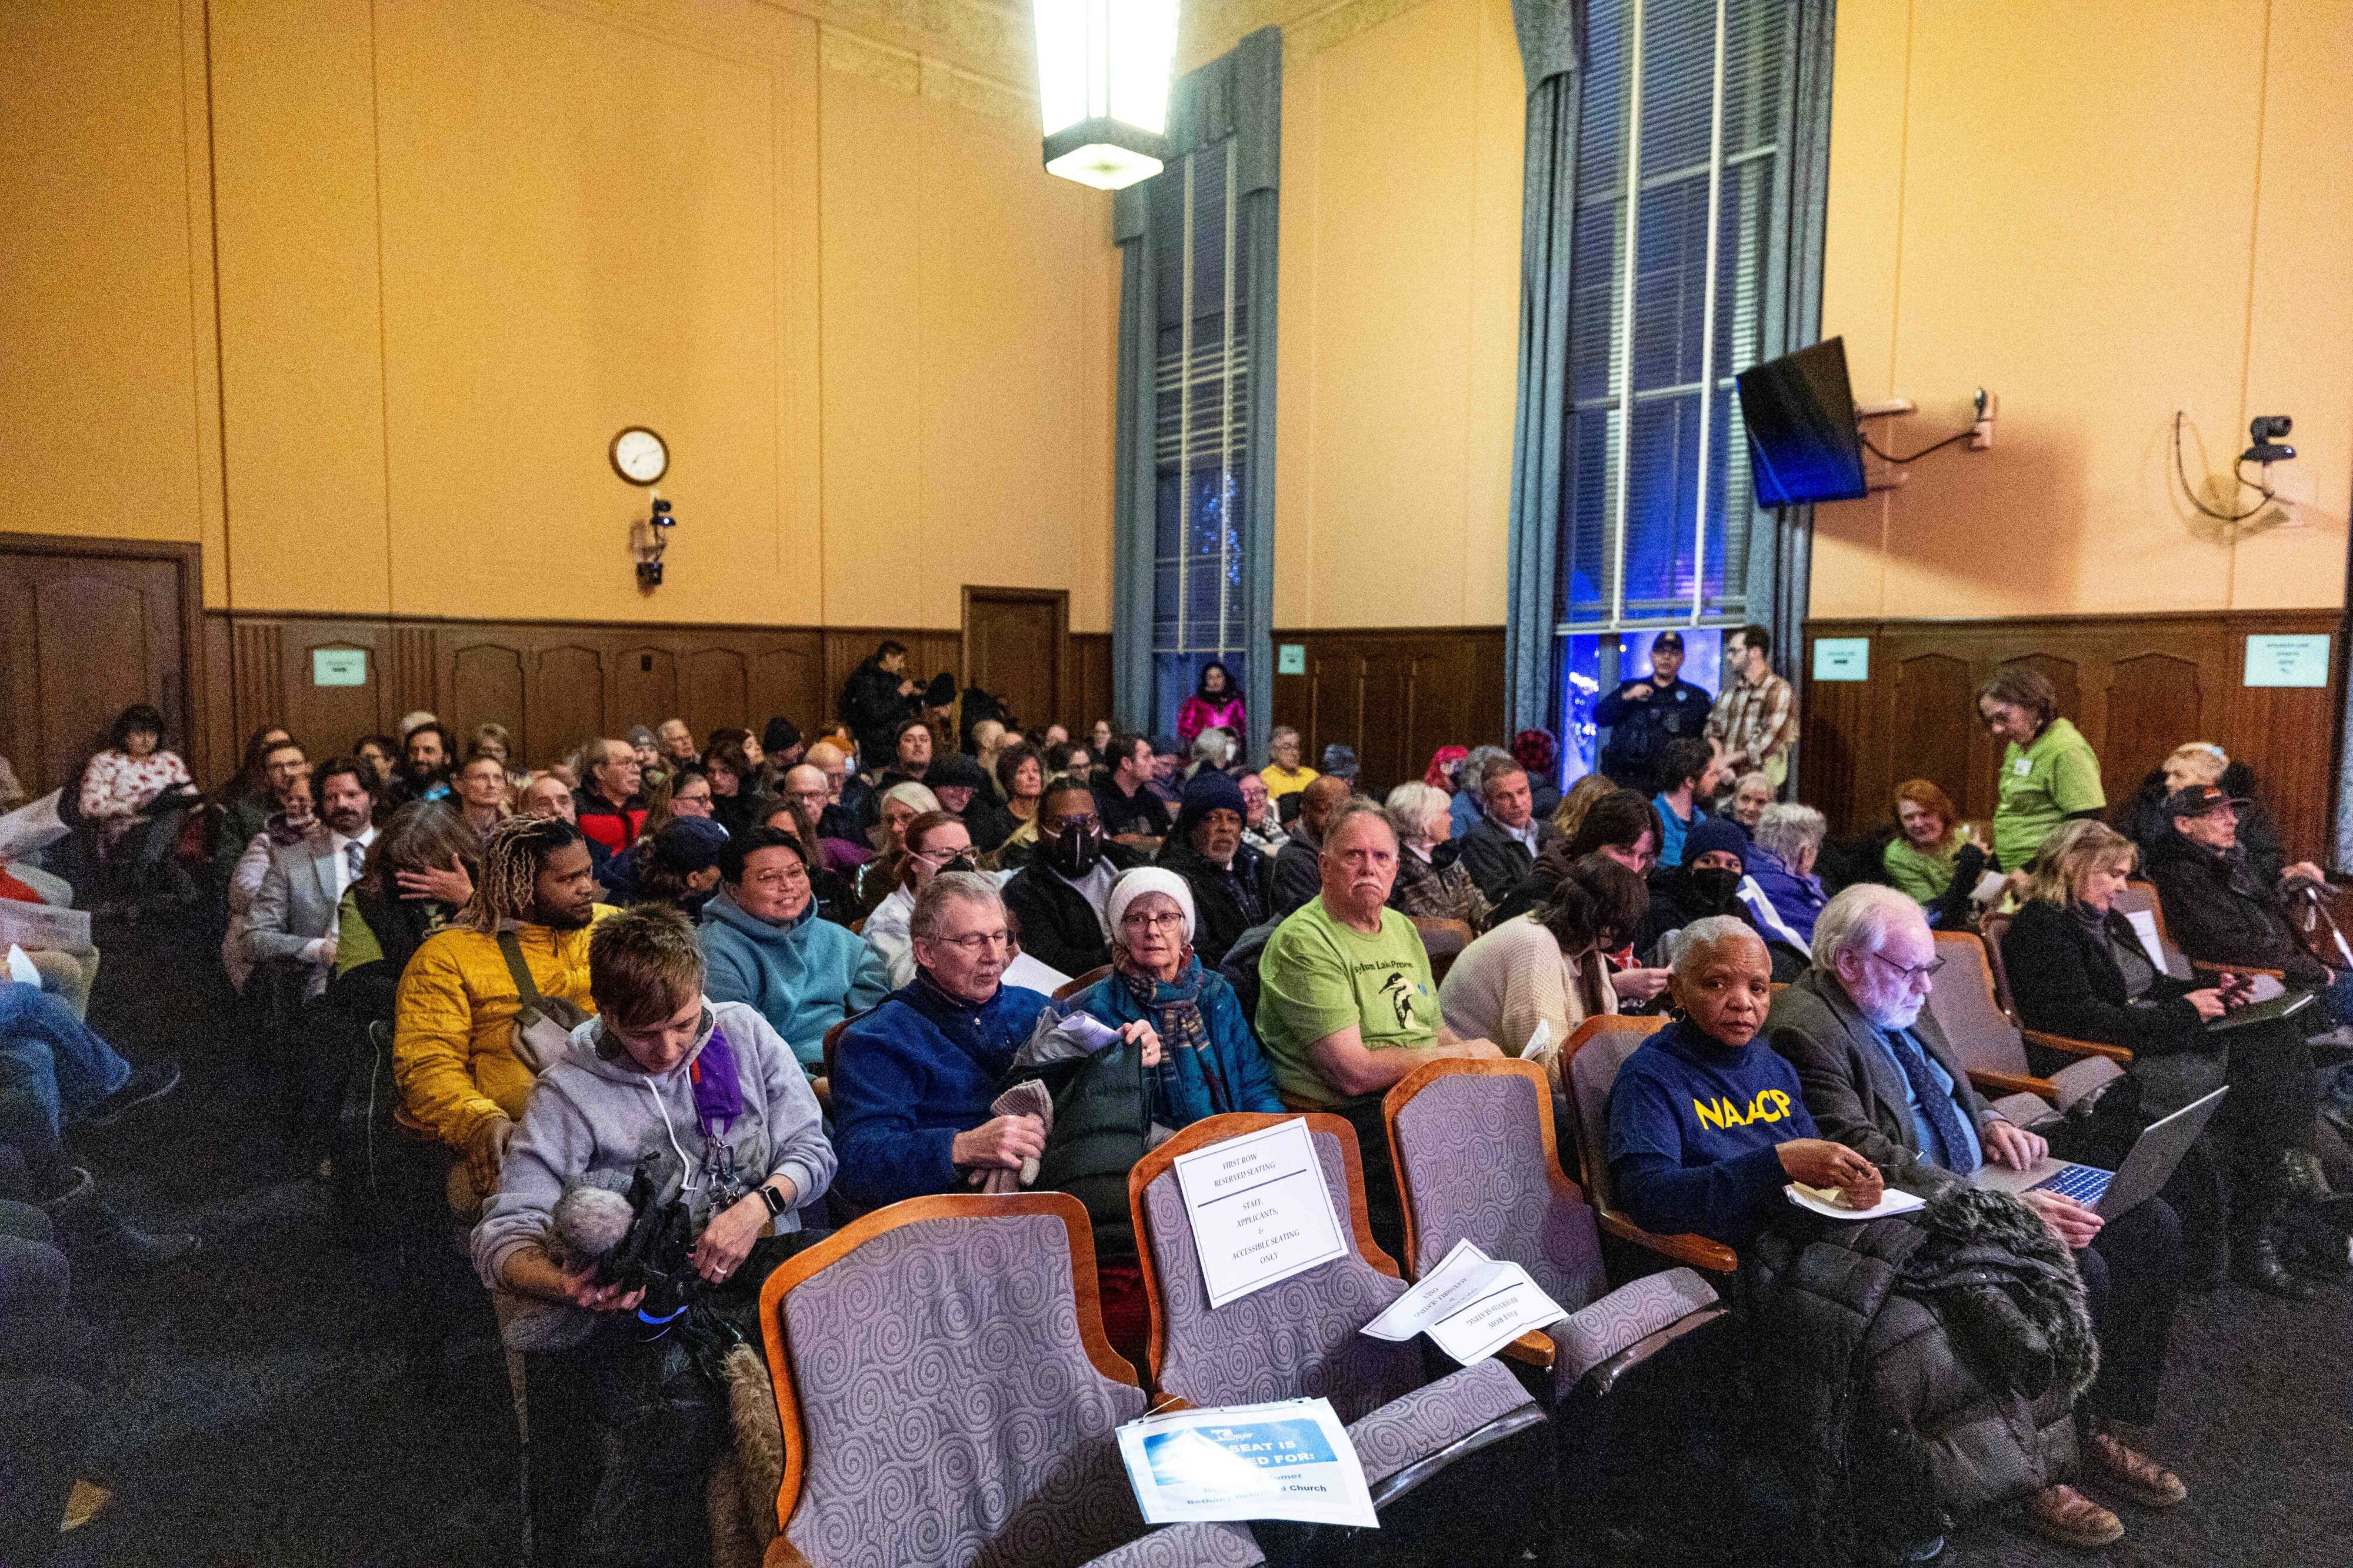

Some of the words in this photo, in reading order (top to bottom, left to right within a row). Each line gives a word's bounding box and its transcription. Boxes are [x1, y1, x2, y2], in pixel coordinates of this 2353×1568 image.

[1354, 962, 1375, 975] sylum
[1693, 1089, 1791, 1130] NAACP
[1222, 1158, 1240, 1170] FIRST
[1241, 1153, 1257, 1164] ROW
[1214, 1171, 1246, 1187] RESERVED
[1247, 1161, 1275, 1176] SEATING
[1242, 1198, 1264, 1210] STAFF,
[1237, 1208, 1278, 1228] APPLICANTS,
[1232, 1239, 1270, 1260] ACCESSIBLE
[1271, 1229, 1299, 1245] SEATING
[1260, 1252, 1278, 1264] ONLY
[1423, 1287, 1439, 1299] ONLY
[1414, 1299, 1438, 1317] SEATING
[1466, 1309, 1492, 1326] SEATING
[1488, 1317, 1504, 1329] ROW
[1228, 1442, 1273, 1453] SEAT
[1278, 1441, 1296, 1450] IS
[1273, 1452, 1315, 1463] FOR:
